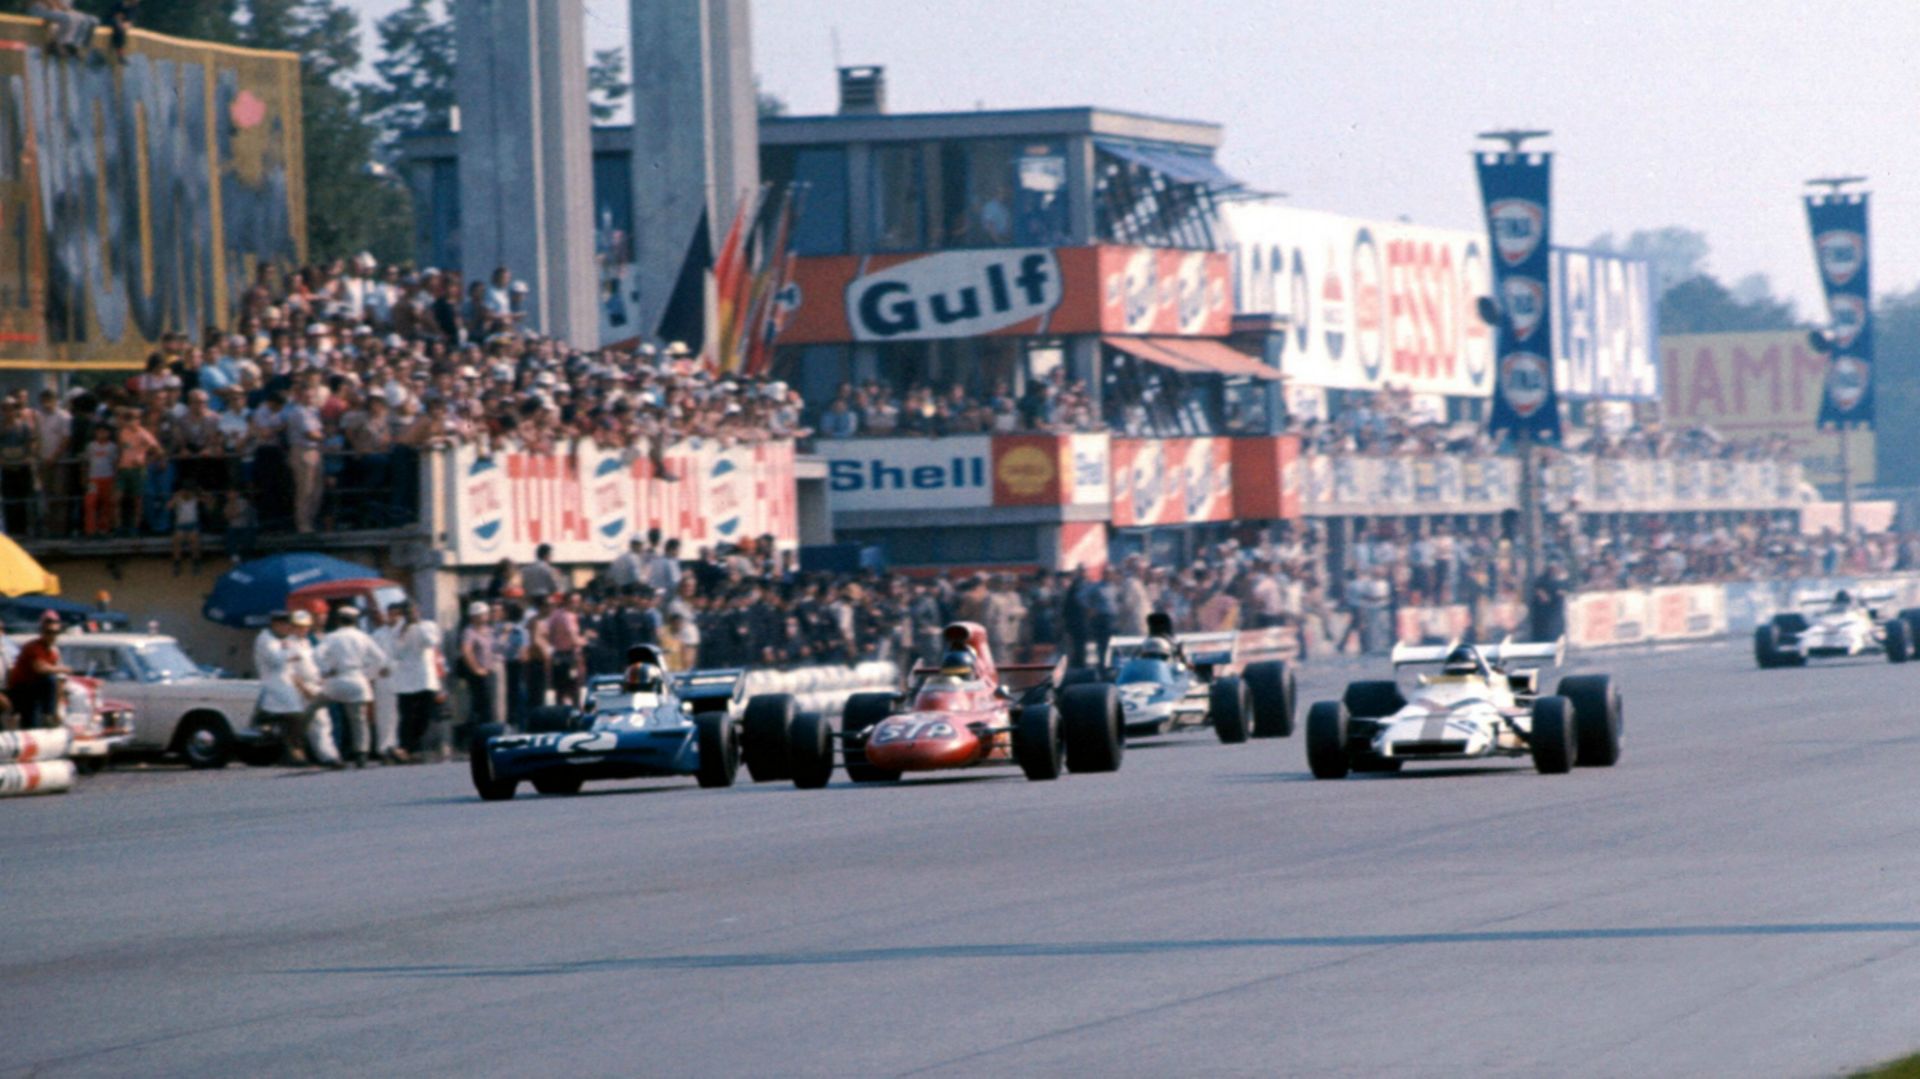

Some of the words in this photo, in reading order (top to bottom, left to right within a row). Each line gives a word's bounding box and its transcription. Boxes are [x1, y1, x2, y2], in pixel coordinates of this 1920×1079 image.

[857, 253, 1050, 336] Gulf
[1387, 239, 1457, 379] ESSO
[829, 456, 984, 492] Shell
[879, 715, 954, 742] STP
